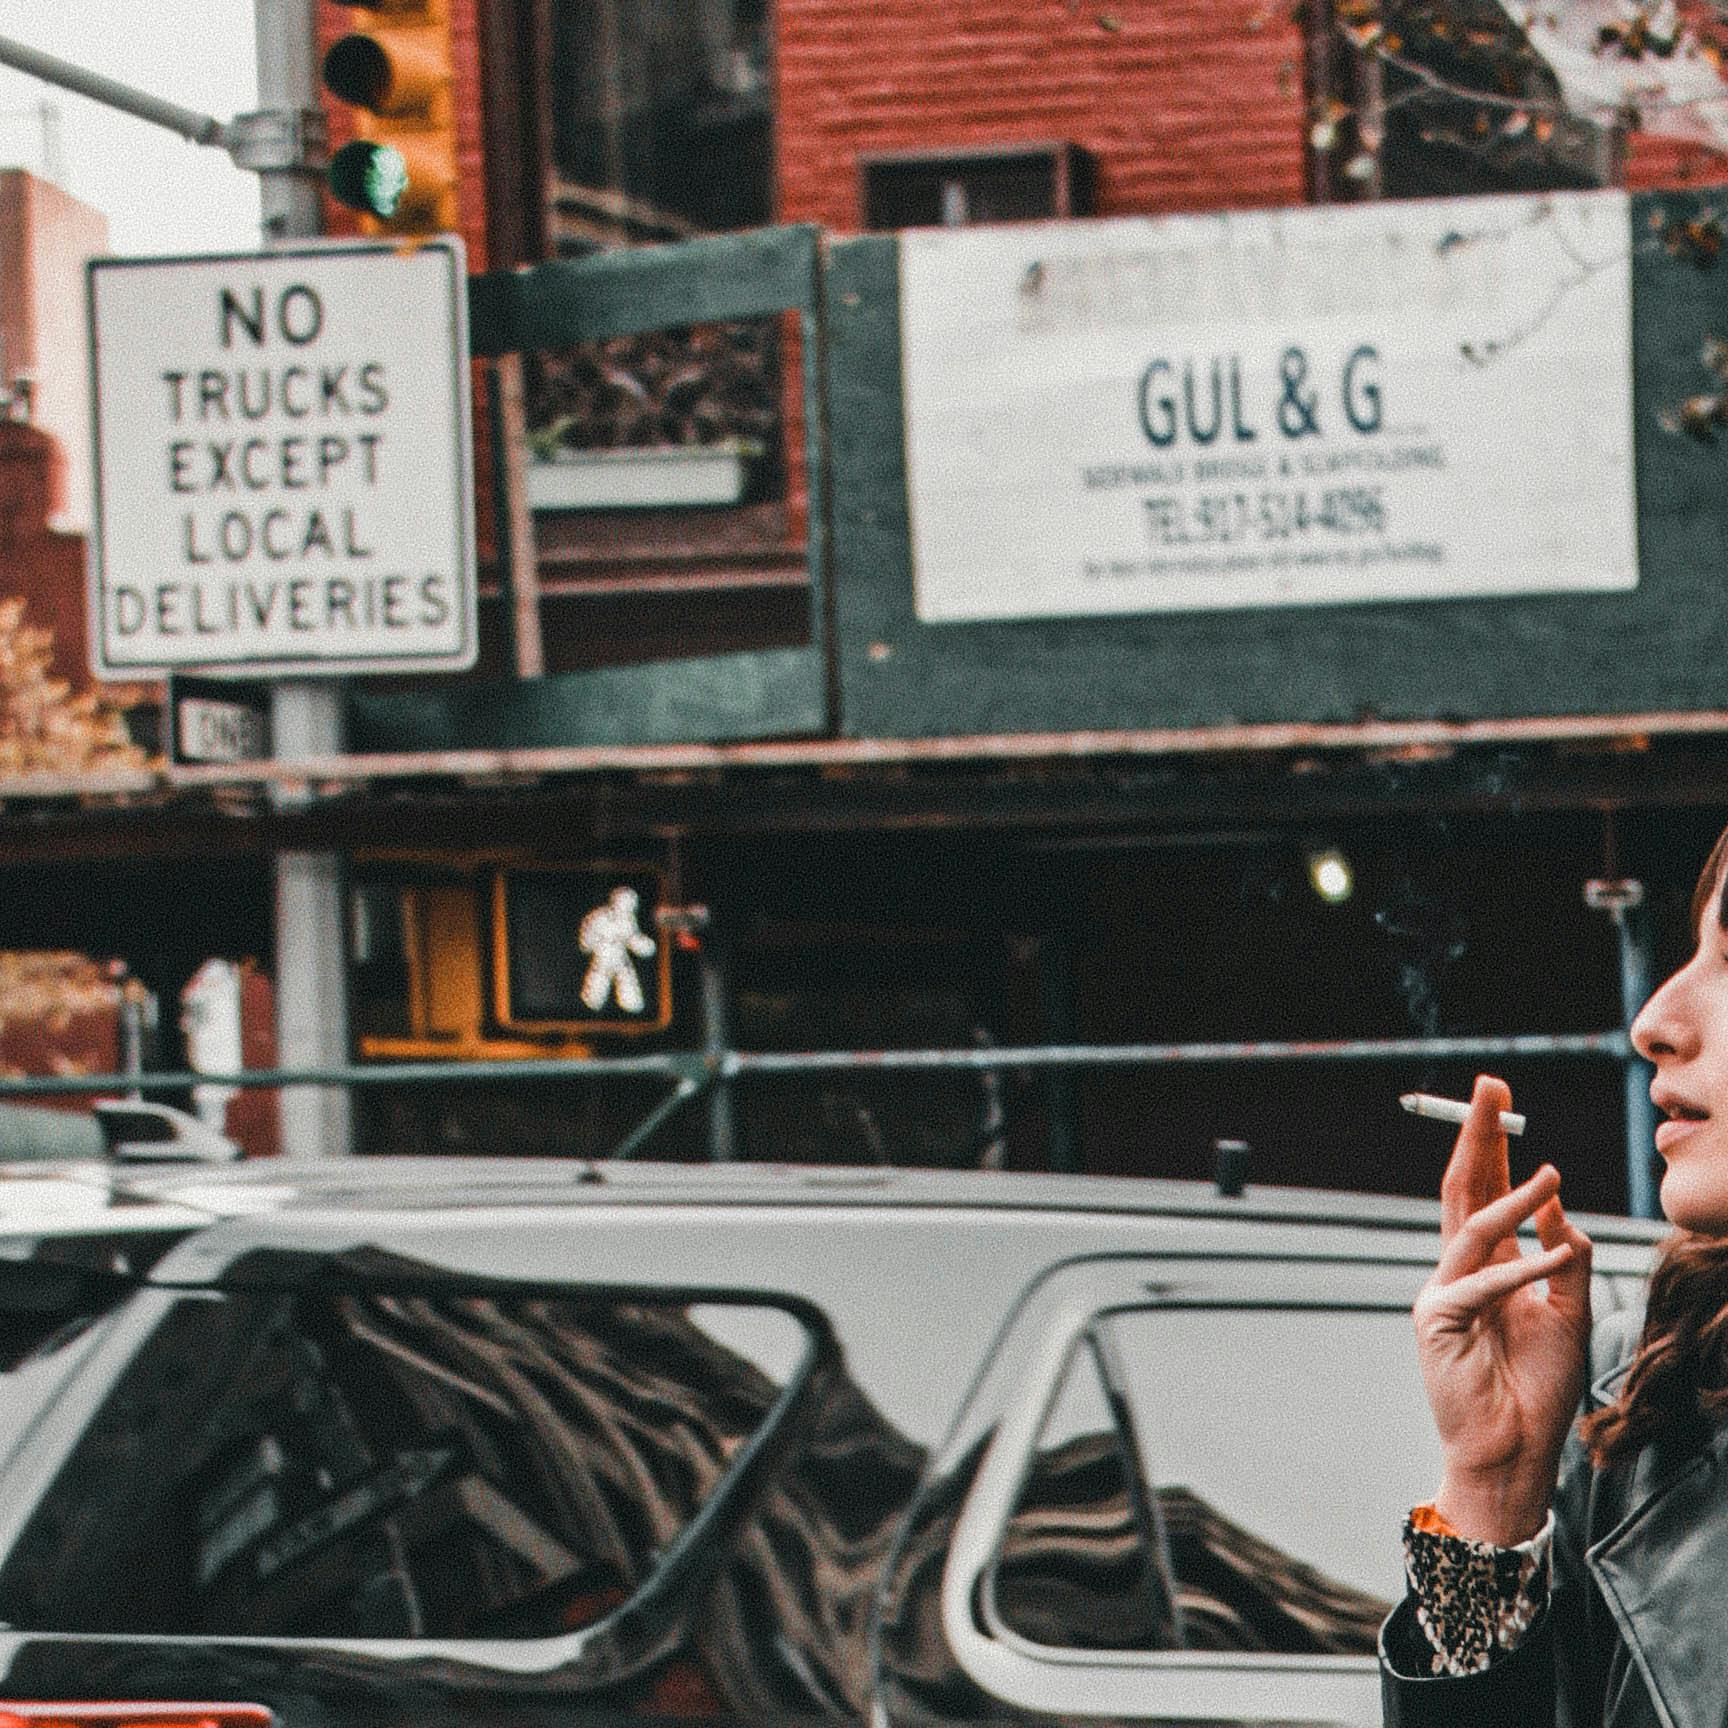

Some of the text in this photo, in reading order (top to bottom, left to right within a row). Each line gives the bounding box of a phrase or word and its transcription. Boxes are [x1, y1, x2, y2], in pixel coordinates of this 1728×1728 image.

[219, 284, 324, 349] NO
[161, 361, 391, 421] TRUCKS
[1138, 343, 1384, 447] GUL & G
[169, 431, 383, 494] EXCEPT
[182, 507, 374, 565] LOCAL
[115, 572, 449, 639] DELIVERIES
